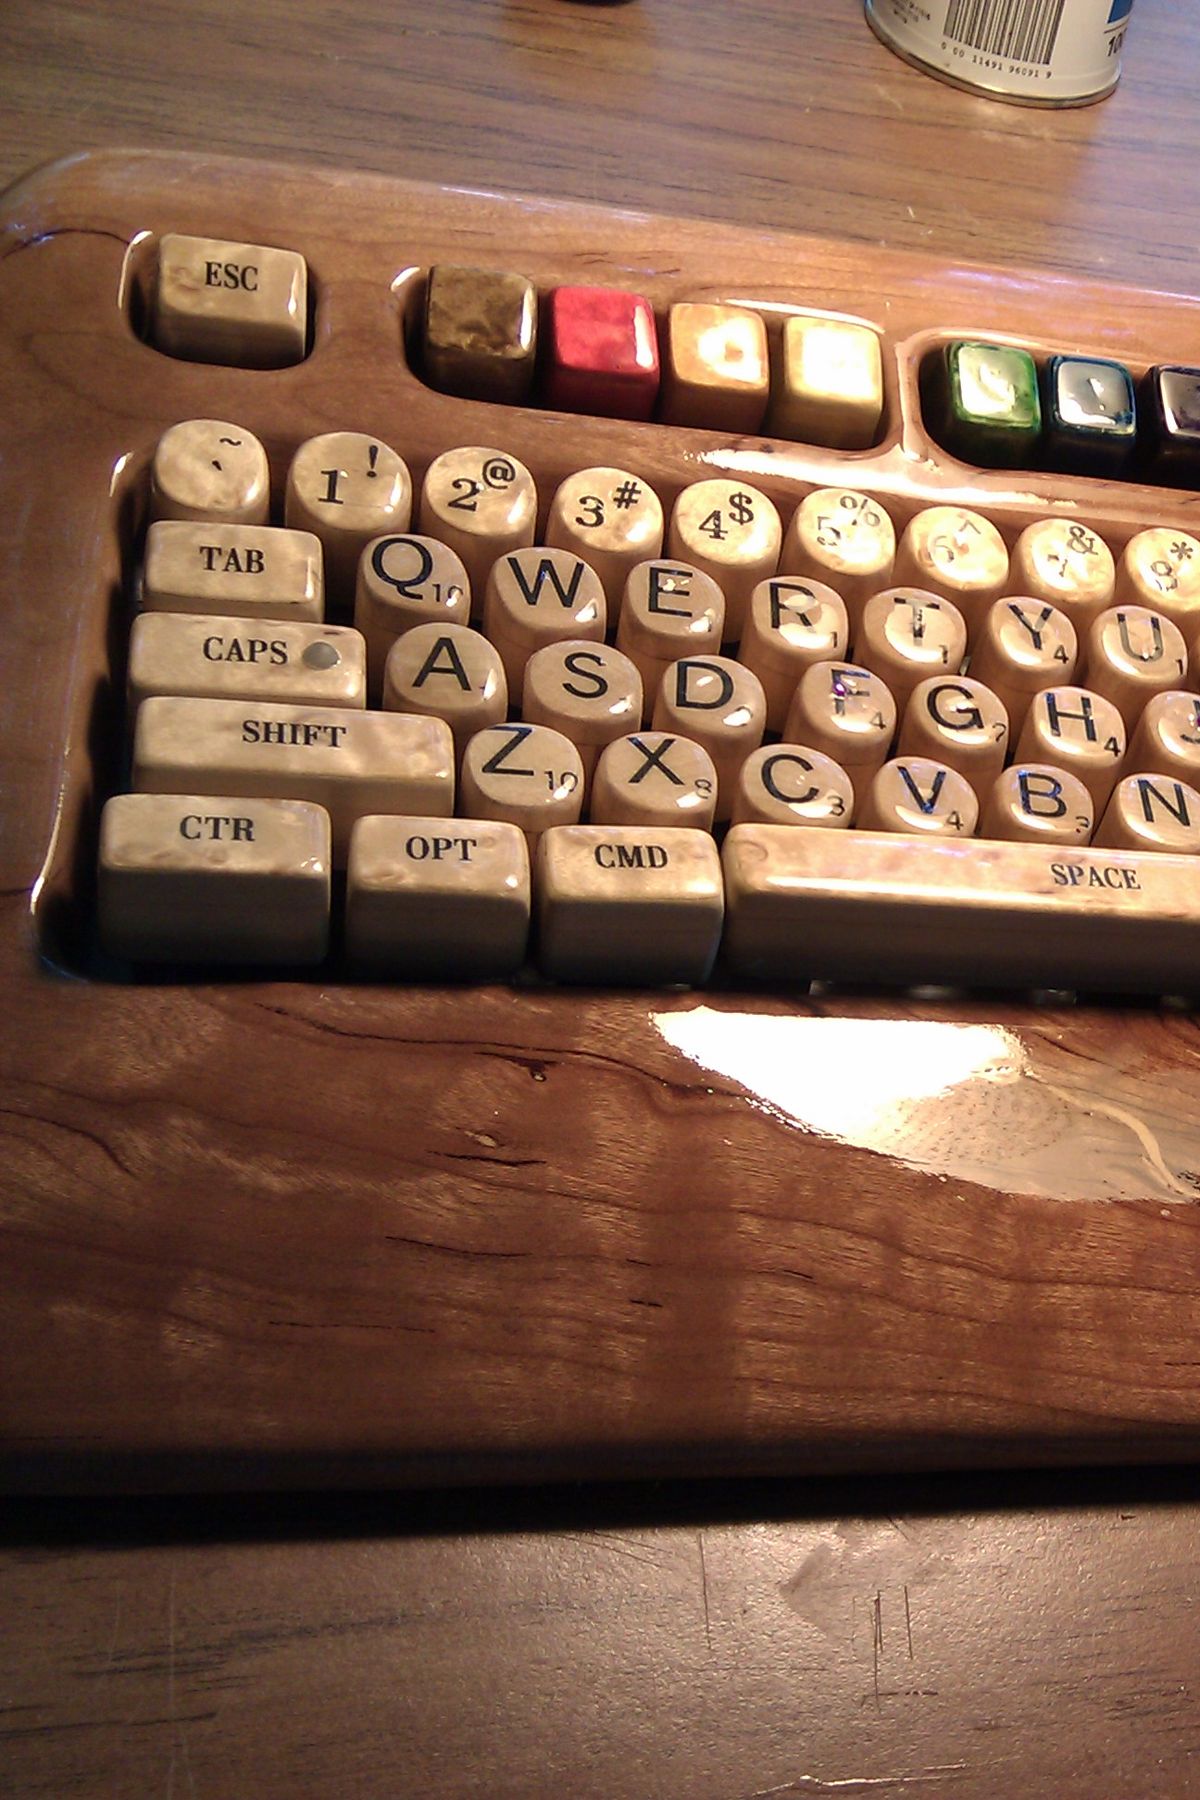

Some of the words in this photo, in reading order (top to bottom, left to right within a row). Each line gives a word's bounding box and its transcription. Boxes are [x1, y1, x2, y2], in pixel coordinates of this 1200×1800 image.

[205, 261, 259, 291] ESC
[317, 469, 343, 504] 1
[448, 477, 480, 511] 2
[482, 457, 515, 490] @
[200, 546, 265, 575] TAB
[371, 537, 434, 600] Q
[507, 556, 585, 608] W
[648, 567, 693, 618] E
[770, 582, 816, 633] R
[894, 597, 940, 646] T
[1008, 603, 1053, 650] Y
[1116, 612, 1163, 662] U
[203, 635, 288, 666] CAPS
[412, 637, 473, 691] A
[562, 652, 609, 698] S
[676, 661, 734, 710] D
[831, 669, 870, 716] F
[926, 684, 984, 730] G
[1046, 692, 1097, 742] H
[241, 719, 347, 749] SHIFT
[482, 726, 535, 776] Z
[627, 737, 685, 785] X
[760, 754, 819, 804] C
[897, 765, 946, 814] V
[1017, 770, 1067, 818] B
[1137, 779, 1190, 827] N
[179, 815, 255, 842] CTR
[405, 836, 477, 862] OPT
[594, 844, 669, 869] CMD
[1050, 863, 1141, 890] SPACE
